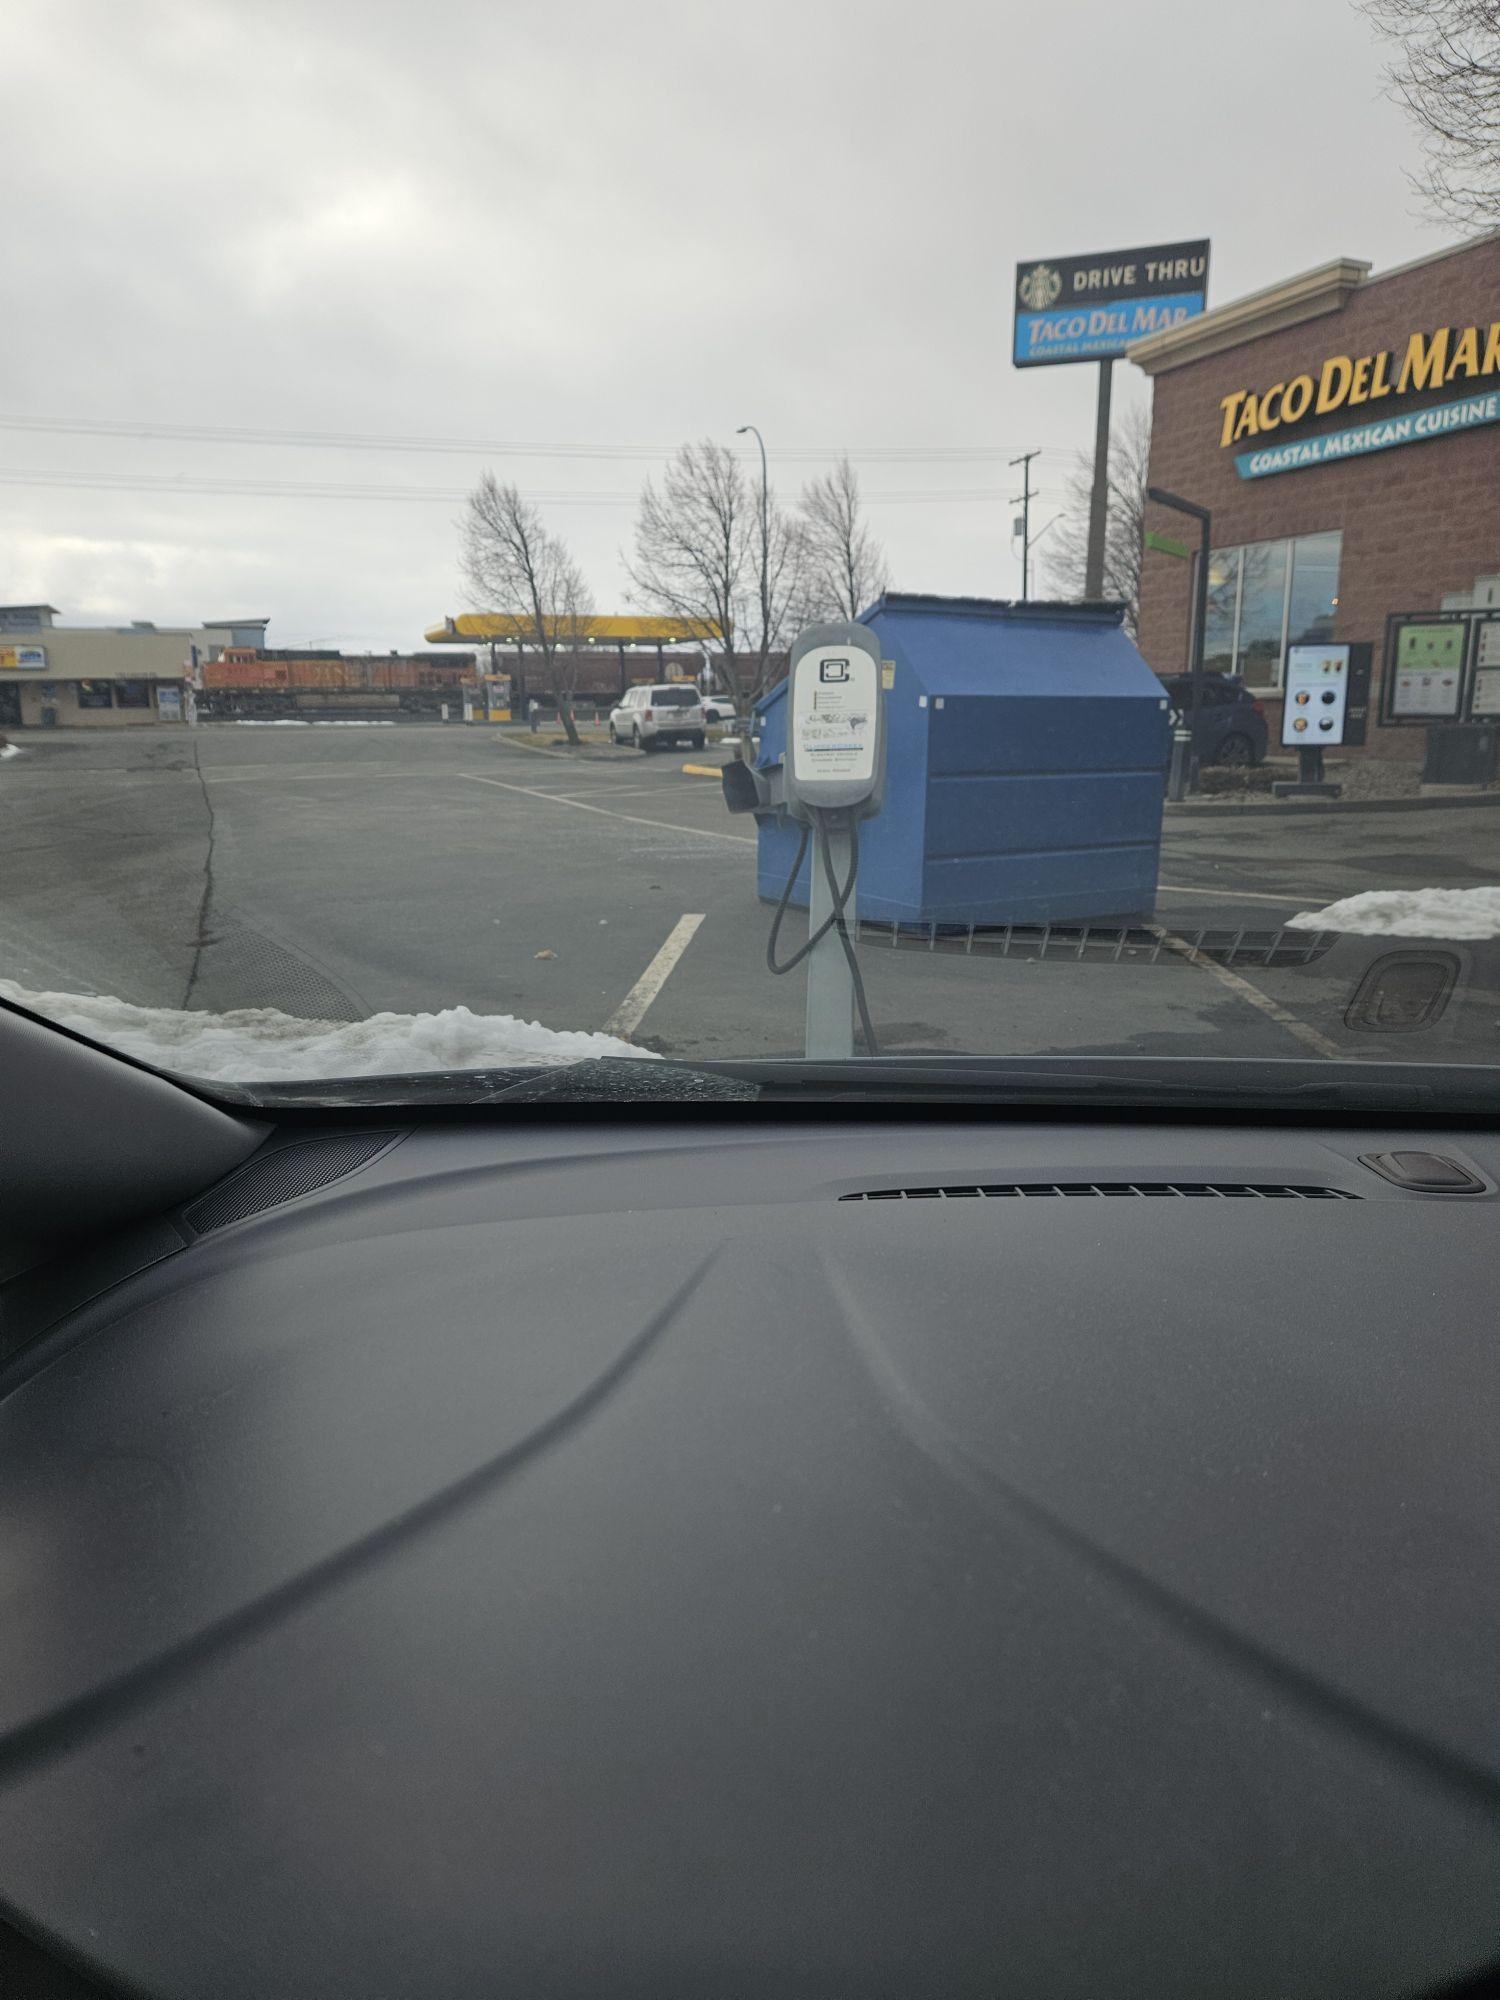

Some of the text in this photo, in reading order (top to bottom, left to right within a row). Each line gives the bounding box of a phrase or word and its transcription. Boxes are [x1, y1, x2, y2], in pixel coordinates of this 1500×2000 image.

[1073, 256, 1206, 291] DRIVE THRU
[1029, 306, 1188, 345] TACO DEL MAR
[1219, 375, 1314, 448] TACO
[1315, 351, 1390, 415] DEL
[1250, 396, 1498, 474] COASTAL MEXICAN CUISINE
